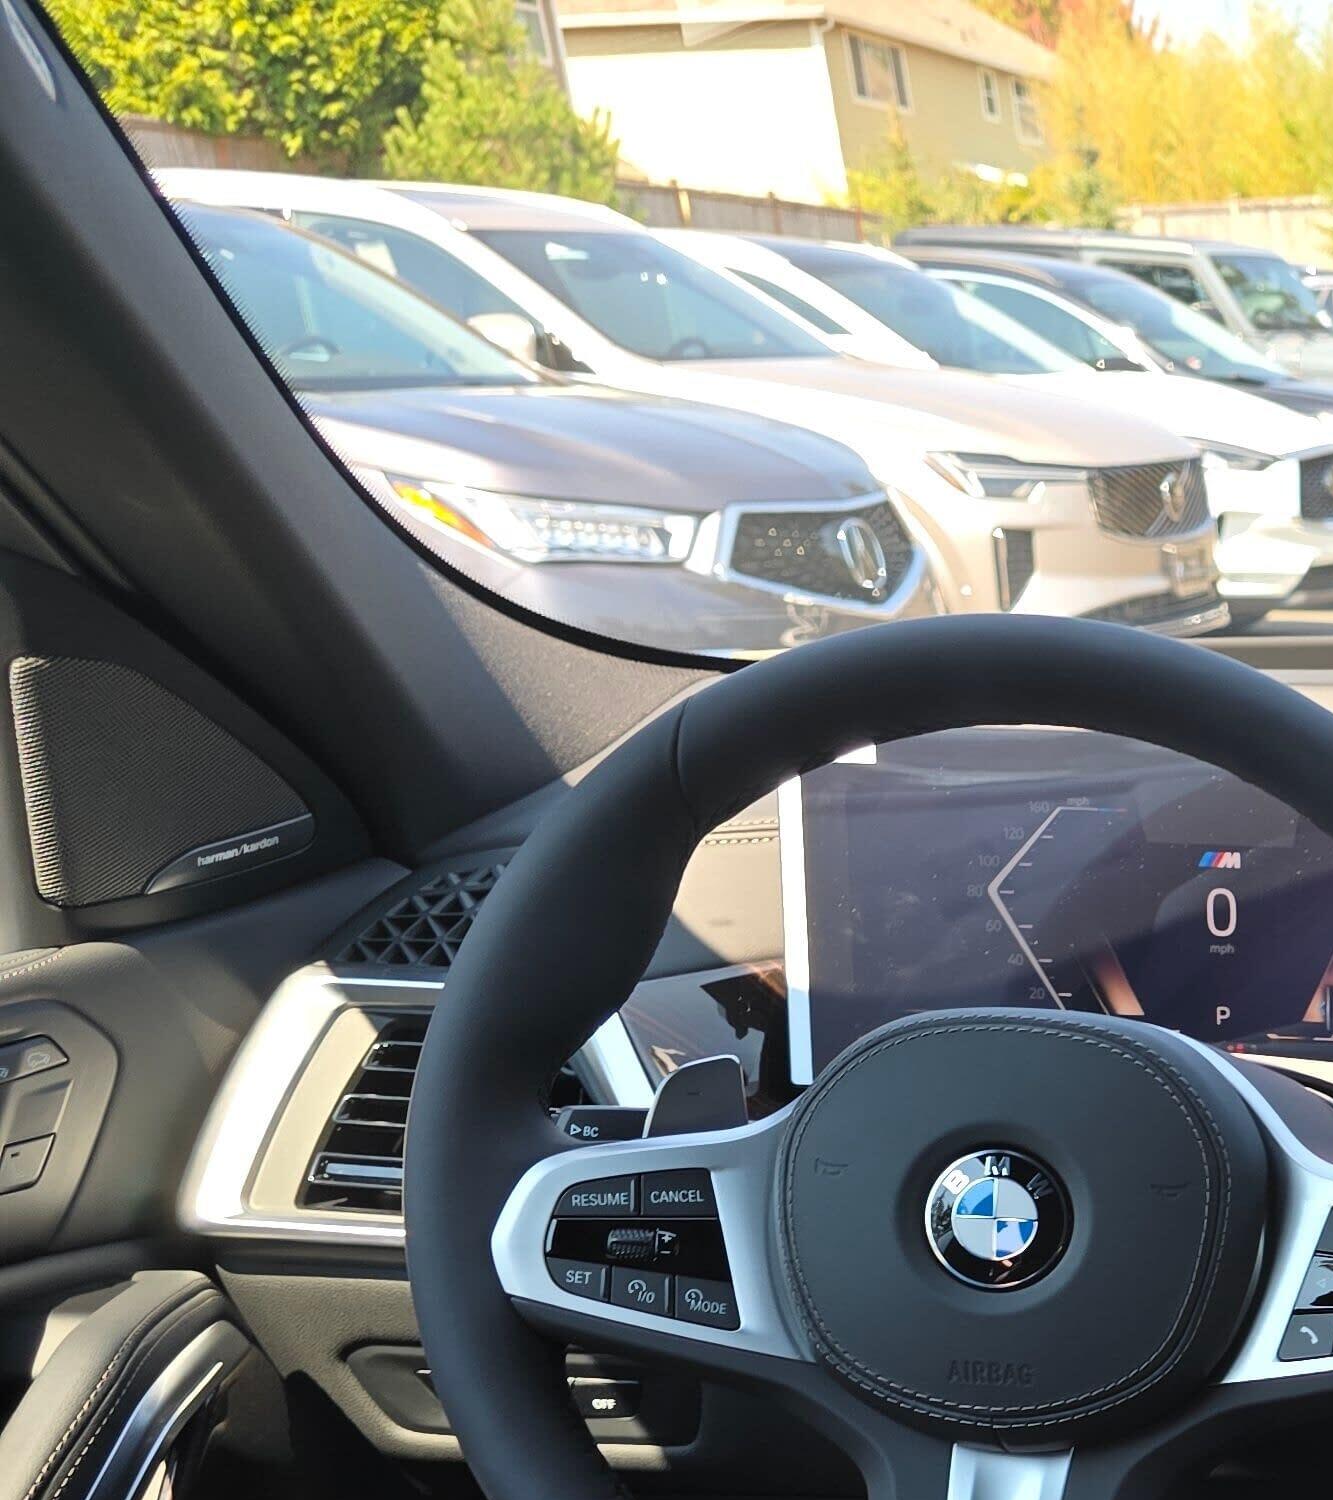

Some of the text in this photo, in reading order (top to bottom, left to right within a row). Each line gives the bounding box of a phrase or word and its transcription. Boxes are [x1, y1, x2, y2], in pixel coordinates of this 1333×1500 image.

[977, 855, 1000, 867] 100
[1206, 888, 1237, 937] 0
[985, 919, 1002, 933] 60
[1209, 943, 1235, 956] mph
[1007, 953, 1024, 967] 40
[1028, 986, 1046, 1000] 20
[1216, 1006, 1231, 1026] P
[583, 1125, 599, 1138] BC
[942, 1155, 1055, 1200] BMW
[571, 1191, 629, 1207] RESUME
[650, 1189, 704, 1204] CANCEL
[566, 1270, 592, 1285] SET
[689, 1299, 727, 1315] MODE
[948, 1359, 1036, 1387] AIRBAG
